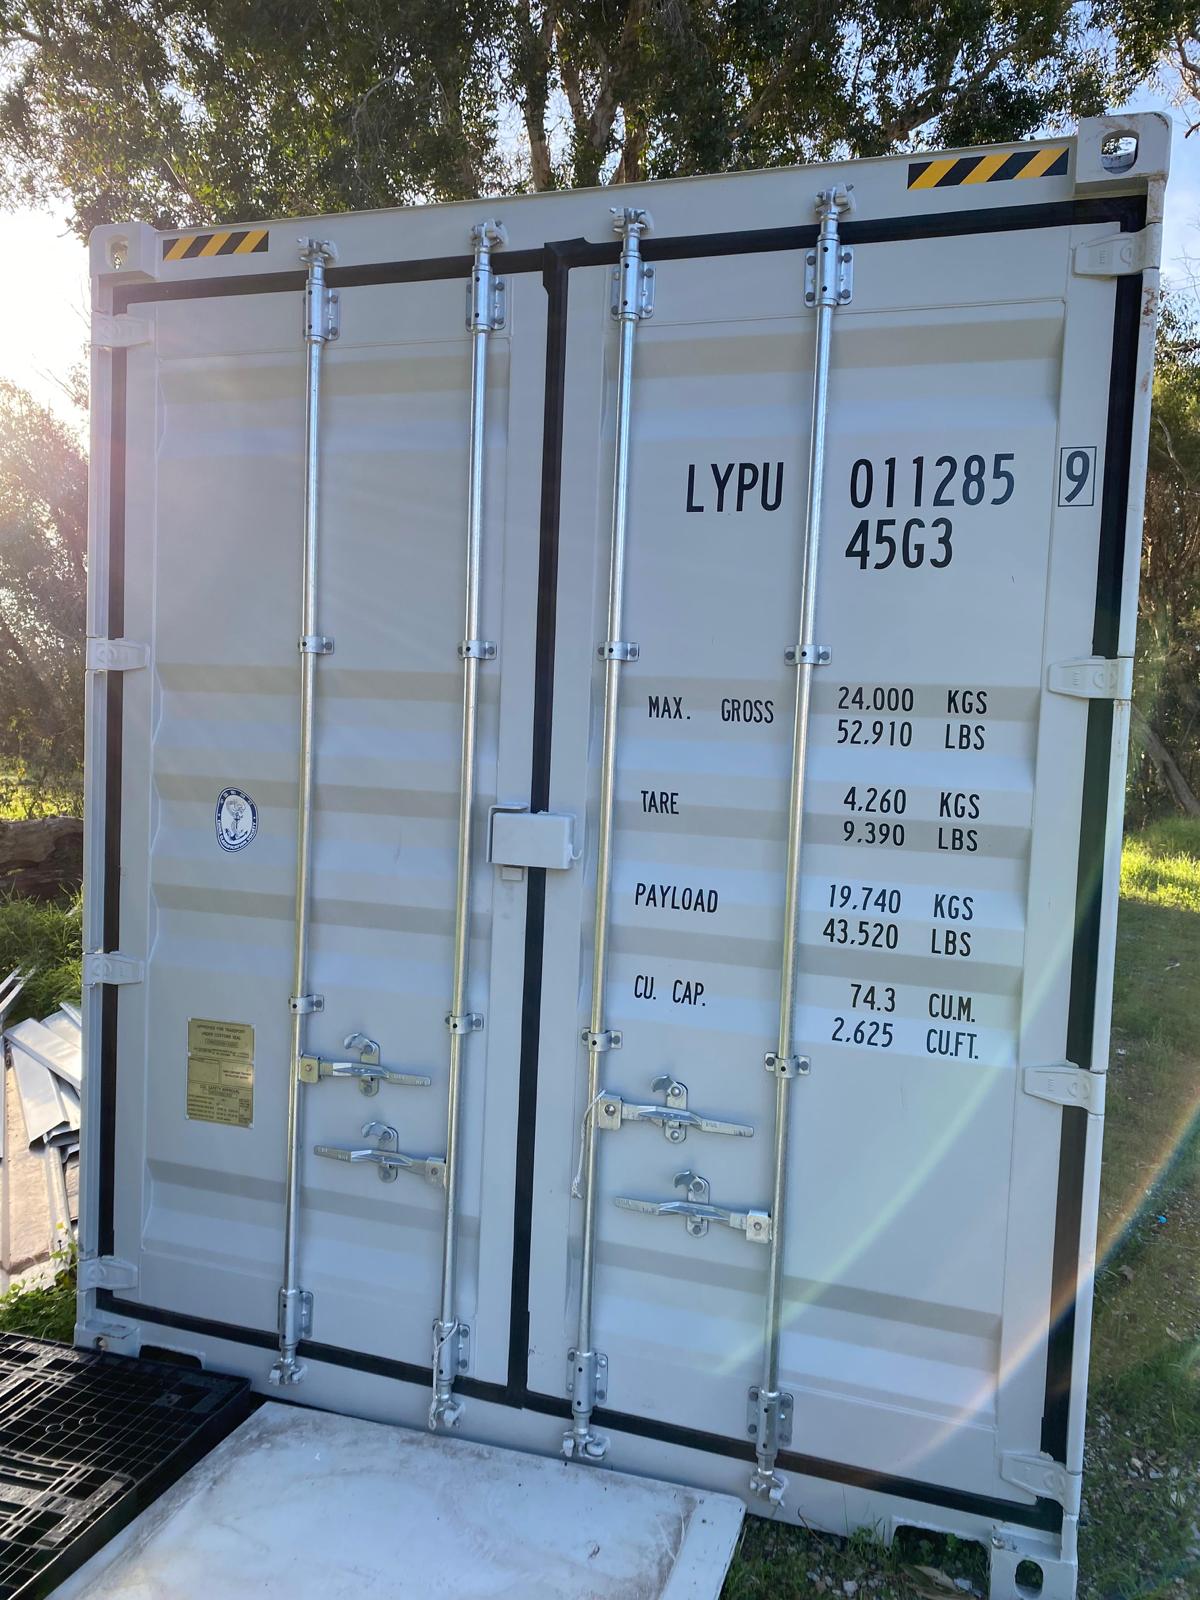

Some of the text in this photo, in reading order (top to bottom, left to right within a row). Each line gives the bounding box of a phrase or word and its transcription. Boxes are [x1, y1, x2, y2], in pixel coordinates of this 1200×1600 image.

[685, 449, 1091, 513] LYPU 011285 9
[844, 516, 953, 570] 45G3
[648, 686, 988, 724] MAX. GROSS 24,000 KGS
[836, 718, 986, 751] 52,910 LBS
[640, 786, 980, 820] TARE 4,260 KGS
[843, 820, 978, 852] 9,390 LBS
[634, 882, 974, 921] PAYLOAD 19,740 KGS
[822, 917, 972, 957] 43,520 LBS
[633, 974, 657, 1001] CU.
[672, 979, 706, 1007] CAP.
[850, 983, 896, 1013] 74.3
[831, 1016, 894, 1048] 2,625
